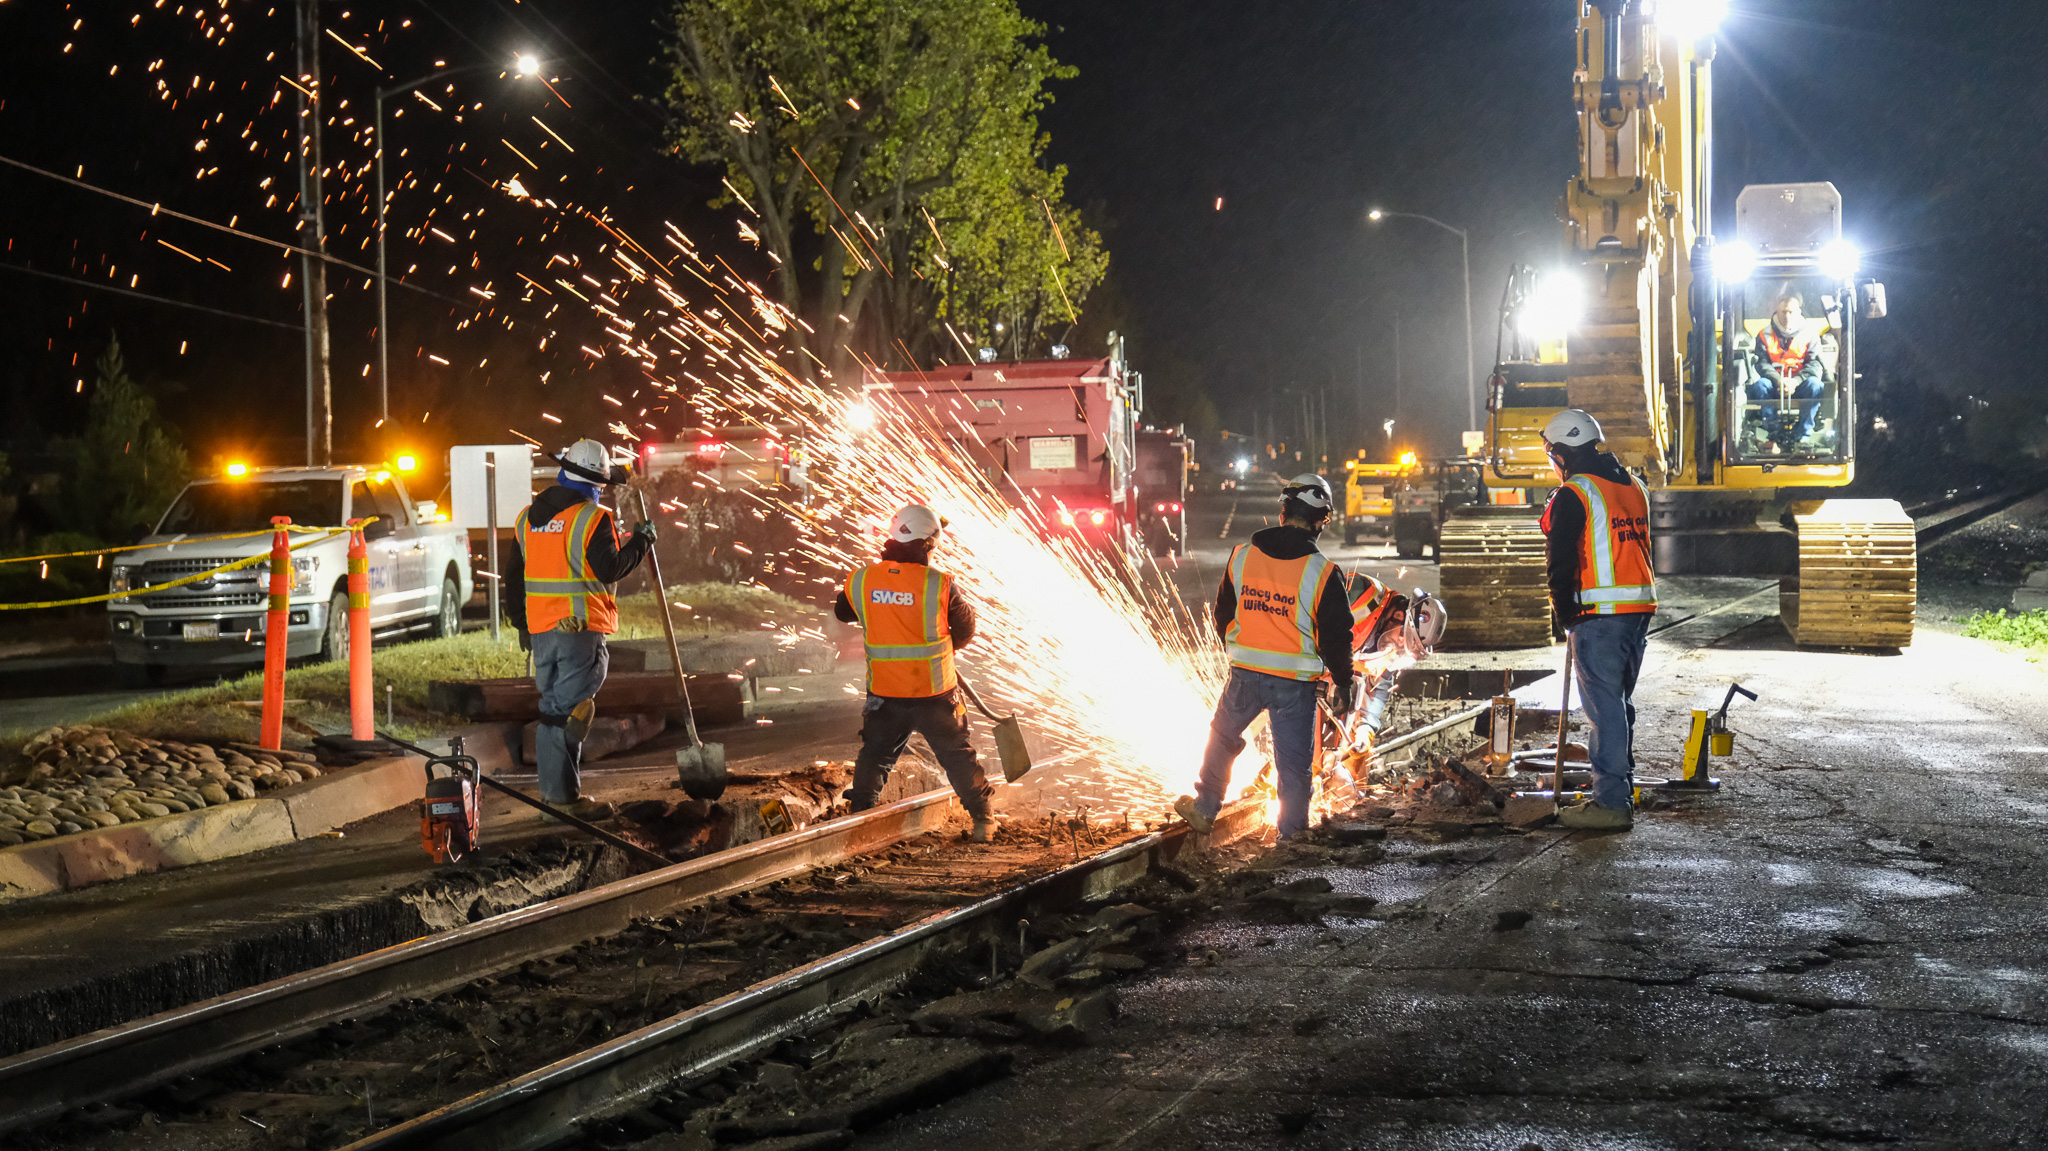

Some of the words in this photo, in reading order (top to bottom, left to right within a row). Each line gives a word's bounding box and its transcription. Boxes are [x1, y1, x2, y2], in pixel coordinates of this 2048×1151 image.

[872, 590, 914, 606] SWGB
[1240, 584, 1271, 602] Stacy
[1273, 593, 1296, 605] and
[1243, 599, 1289, 617] Witbeck
